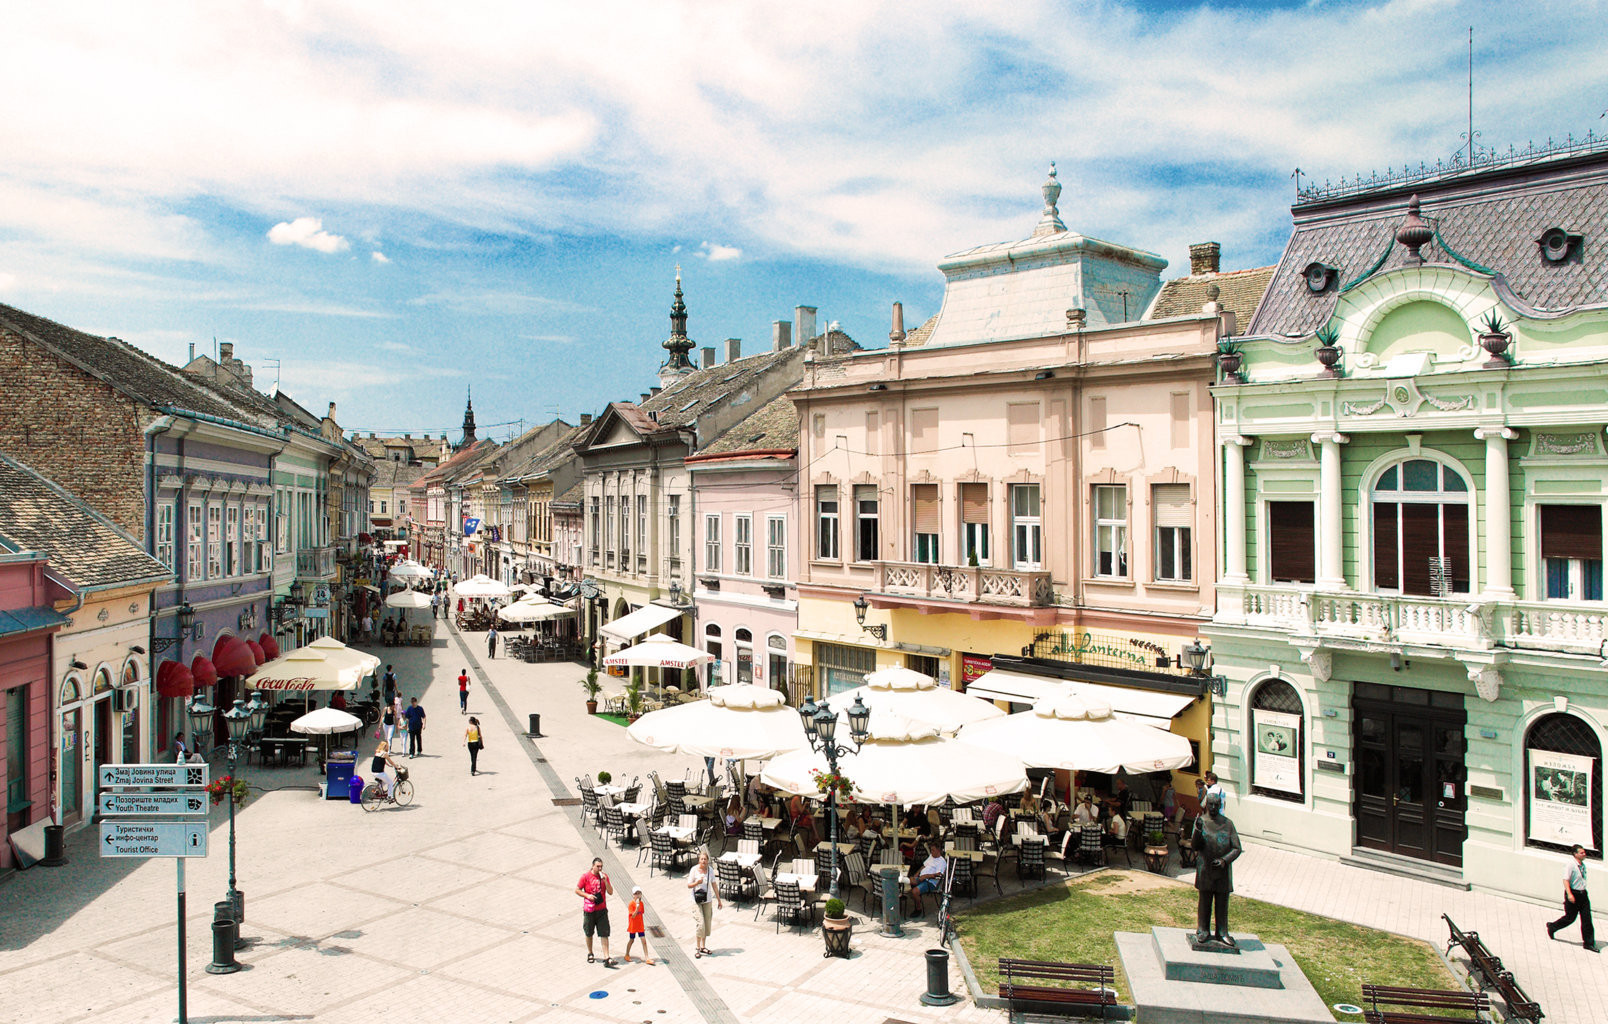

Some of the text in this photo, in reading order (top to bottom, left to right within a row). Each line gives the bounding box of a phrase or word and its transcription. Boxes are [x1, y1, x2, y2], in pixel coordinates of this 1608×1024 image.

[660, 660, 684, 668] AMSTEL
[116, 768, 130, 776] Змај
[116, 777, 132, 785] Zmaj
[116, 796, 152, 805] Позориште
